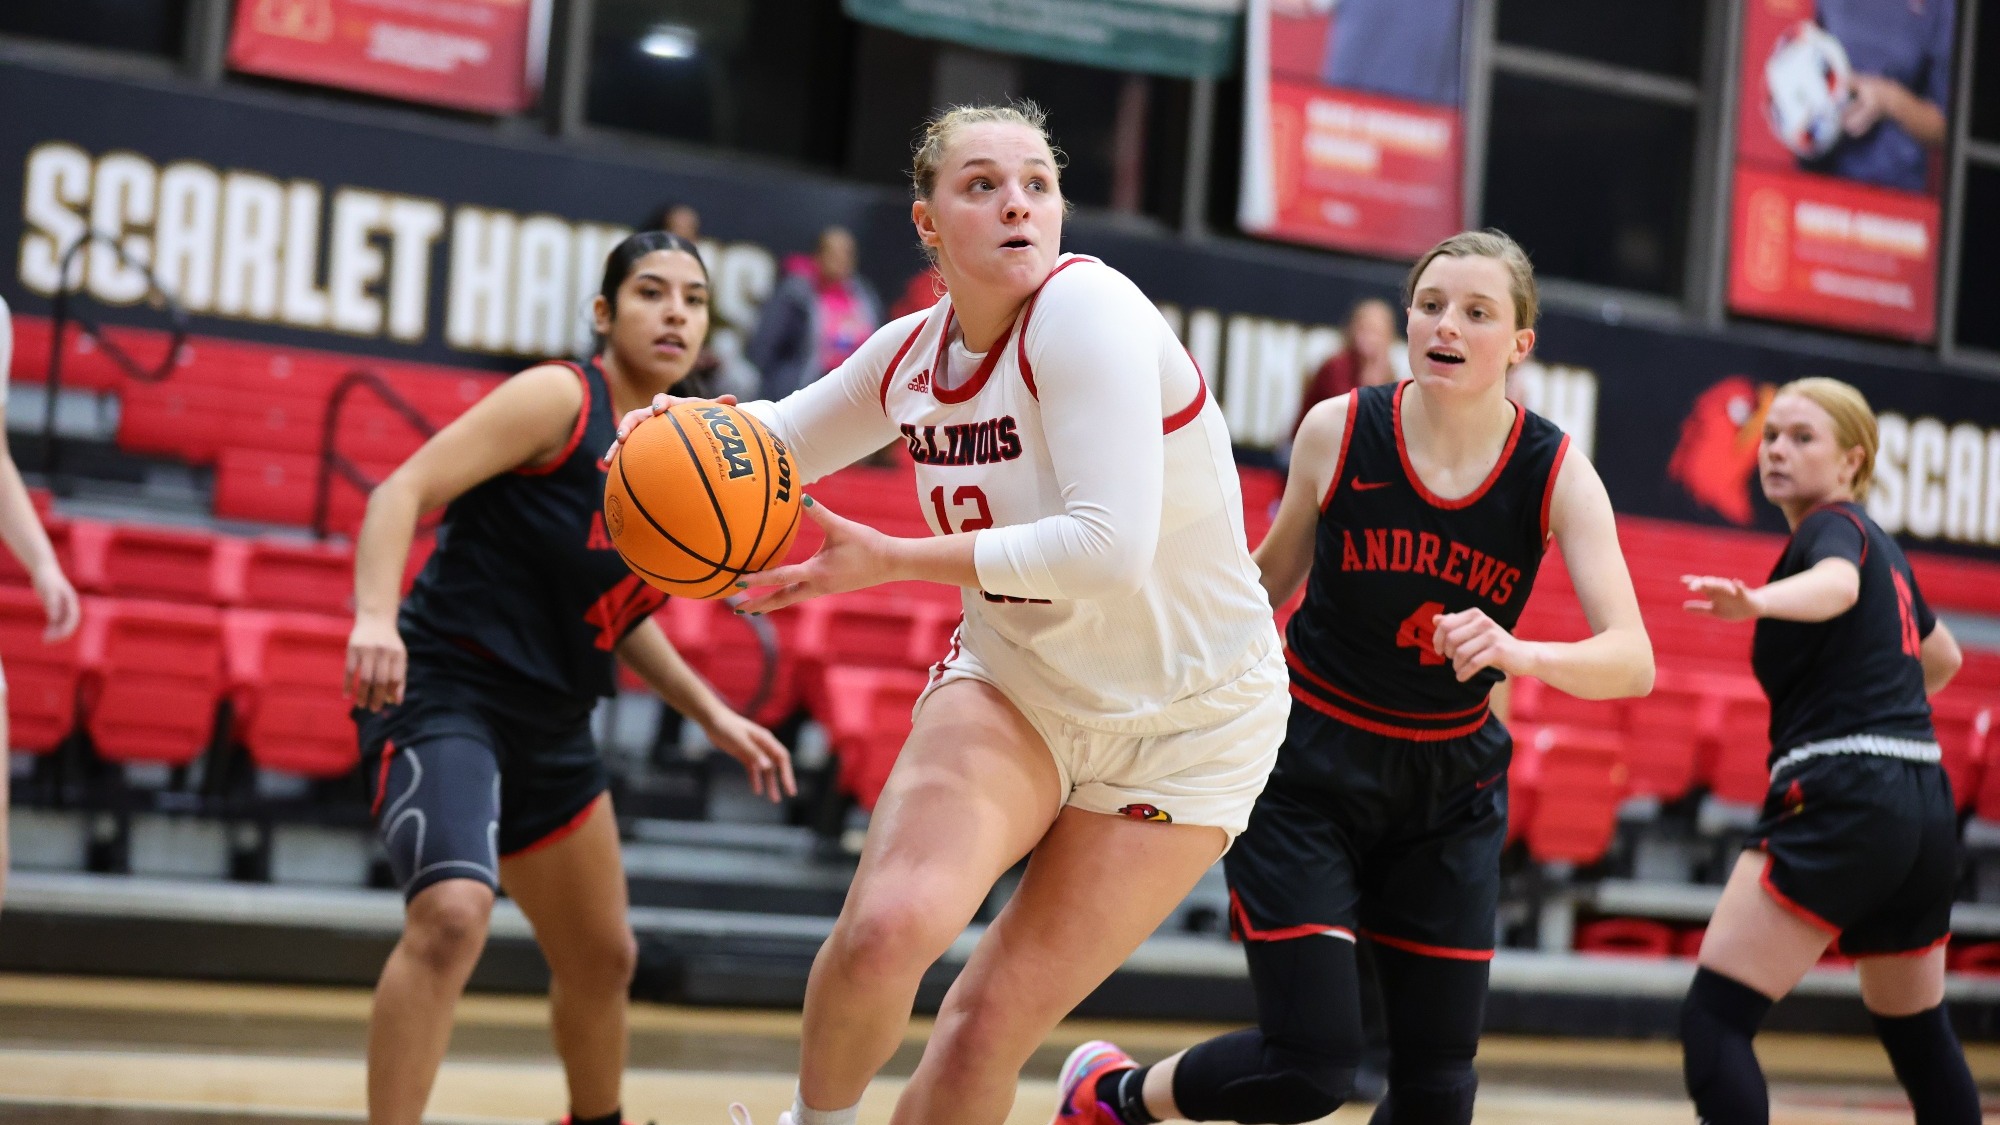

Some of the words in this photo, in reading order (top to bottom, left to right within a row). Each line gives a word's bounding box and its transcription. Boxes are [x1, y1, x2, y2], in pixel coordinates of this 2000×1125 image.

[17, 140, 447, 346] SCARLET
[446, 203, 776, 374] HAS
[907, 381, 929, 394] adida
[693, 406, 754, 480] NCAA
[900, 414, 1023, 466] ILLINOIS
[1341, 528, 1521, 605] ANDREWS
[1396, 601, 1446, 665] 4
